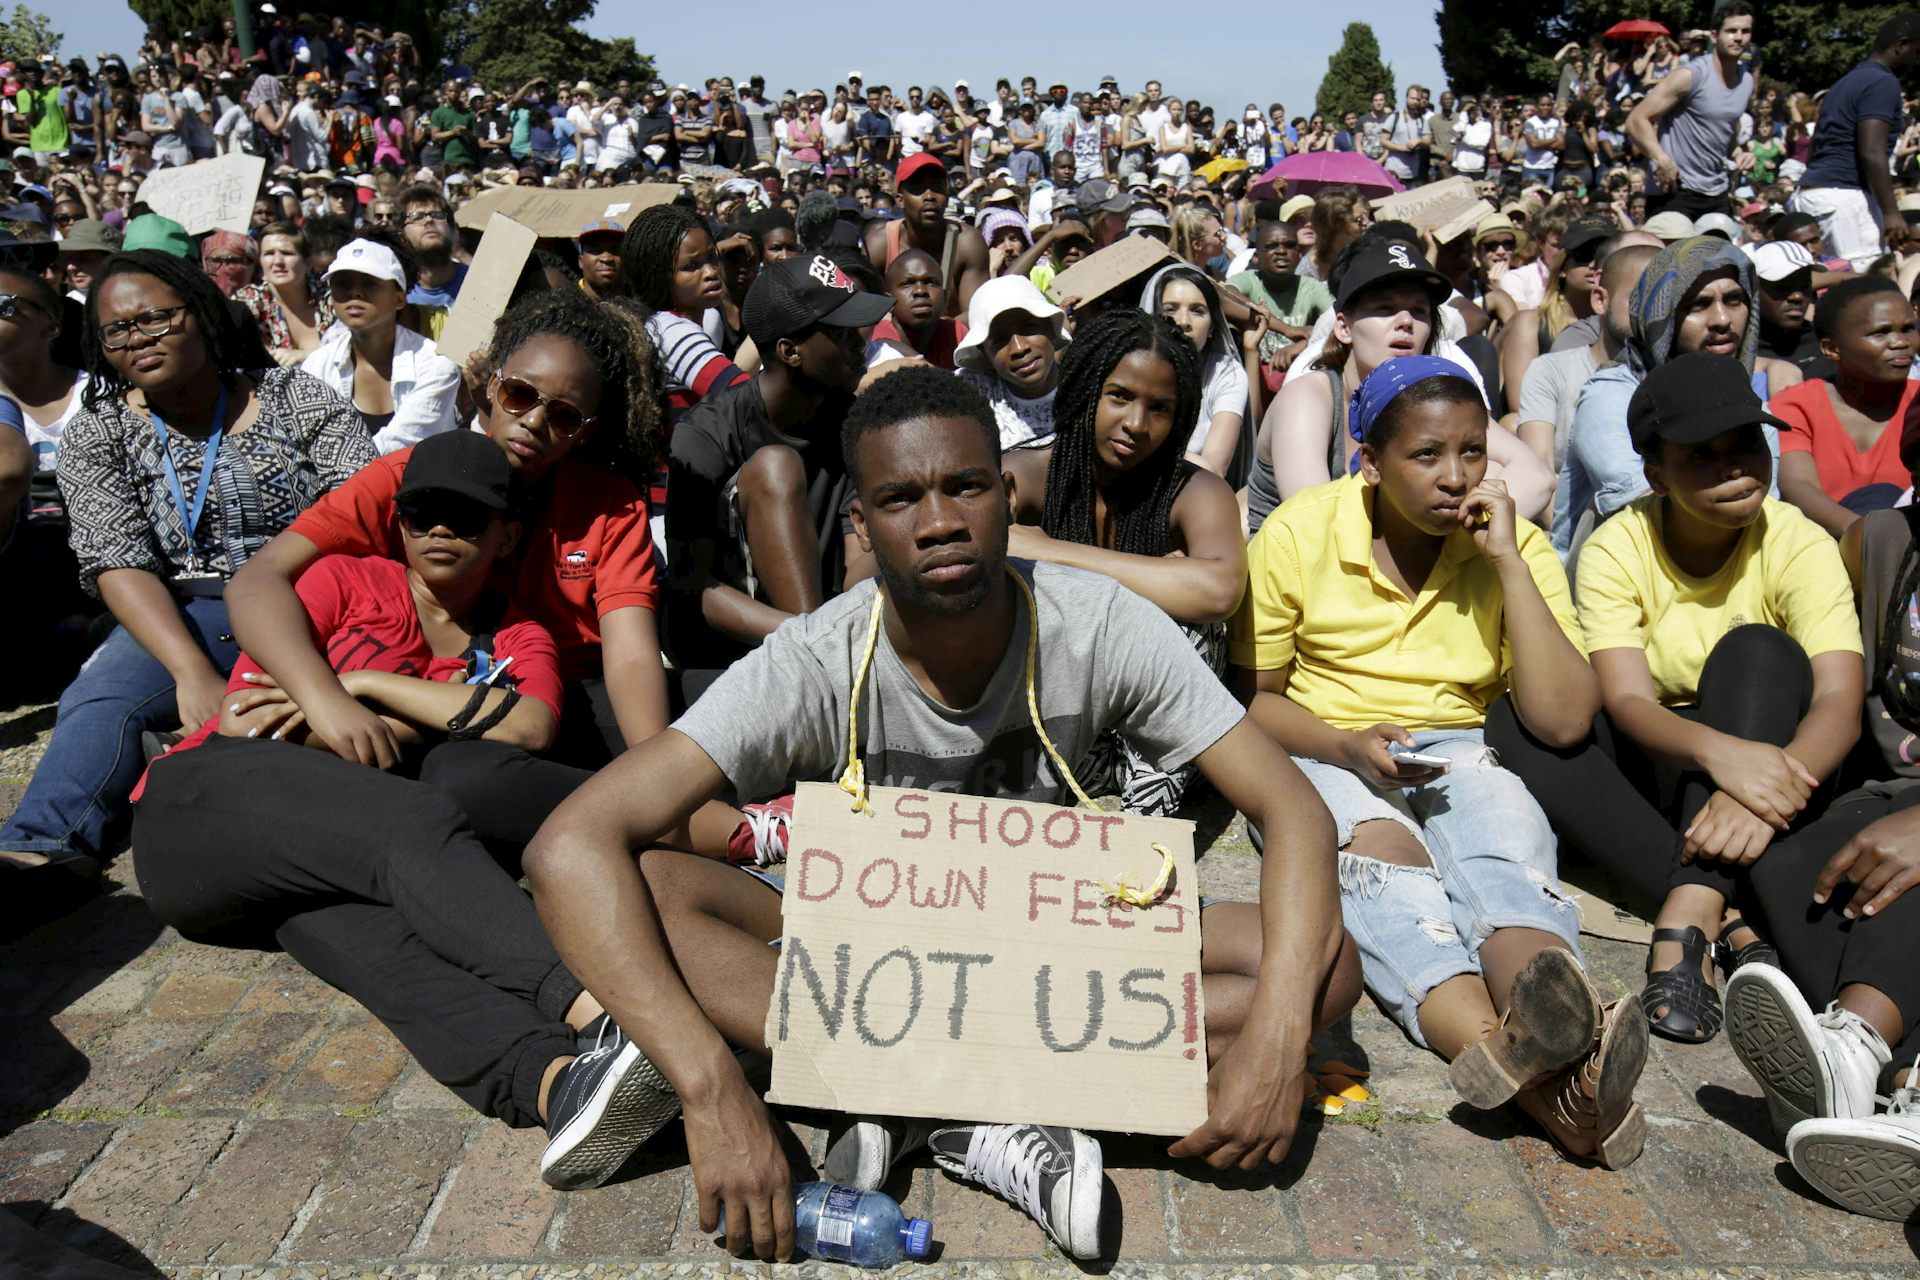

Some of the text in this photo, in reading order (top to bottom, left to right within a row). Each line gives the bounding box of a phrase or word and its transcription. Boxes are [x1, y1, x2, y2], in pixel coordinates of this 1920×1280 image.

[809, 255, 835, 286] EC
[888, 742, 975, 757] THE ONLY THING
[895, 794, 1124, 850] SHOOT
[797, 849, 988, 910] DOWN
[779, 937, 1198, 1060] NOT US!
